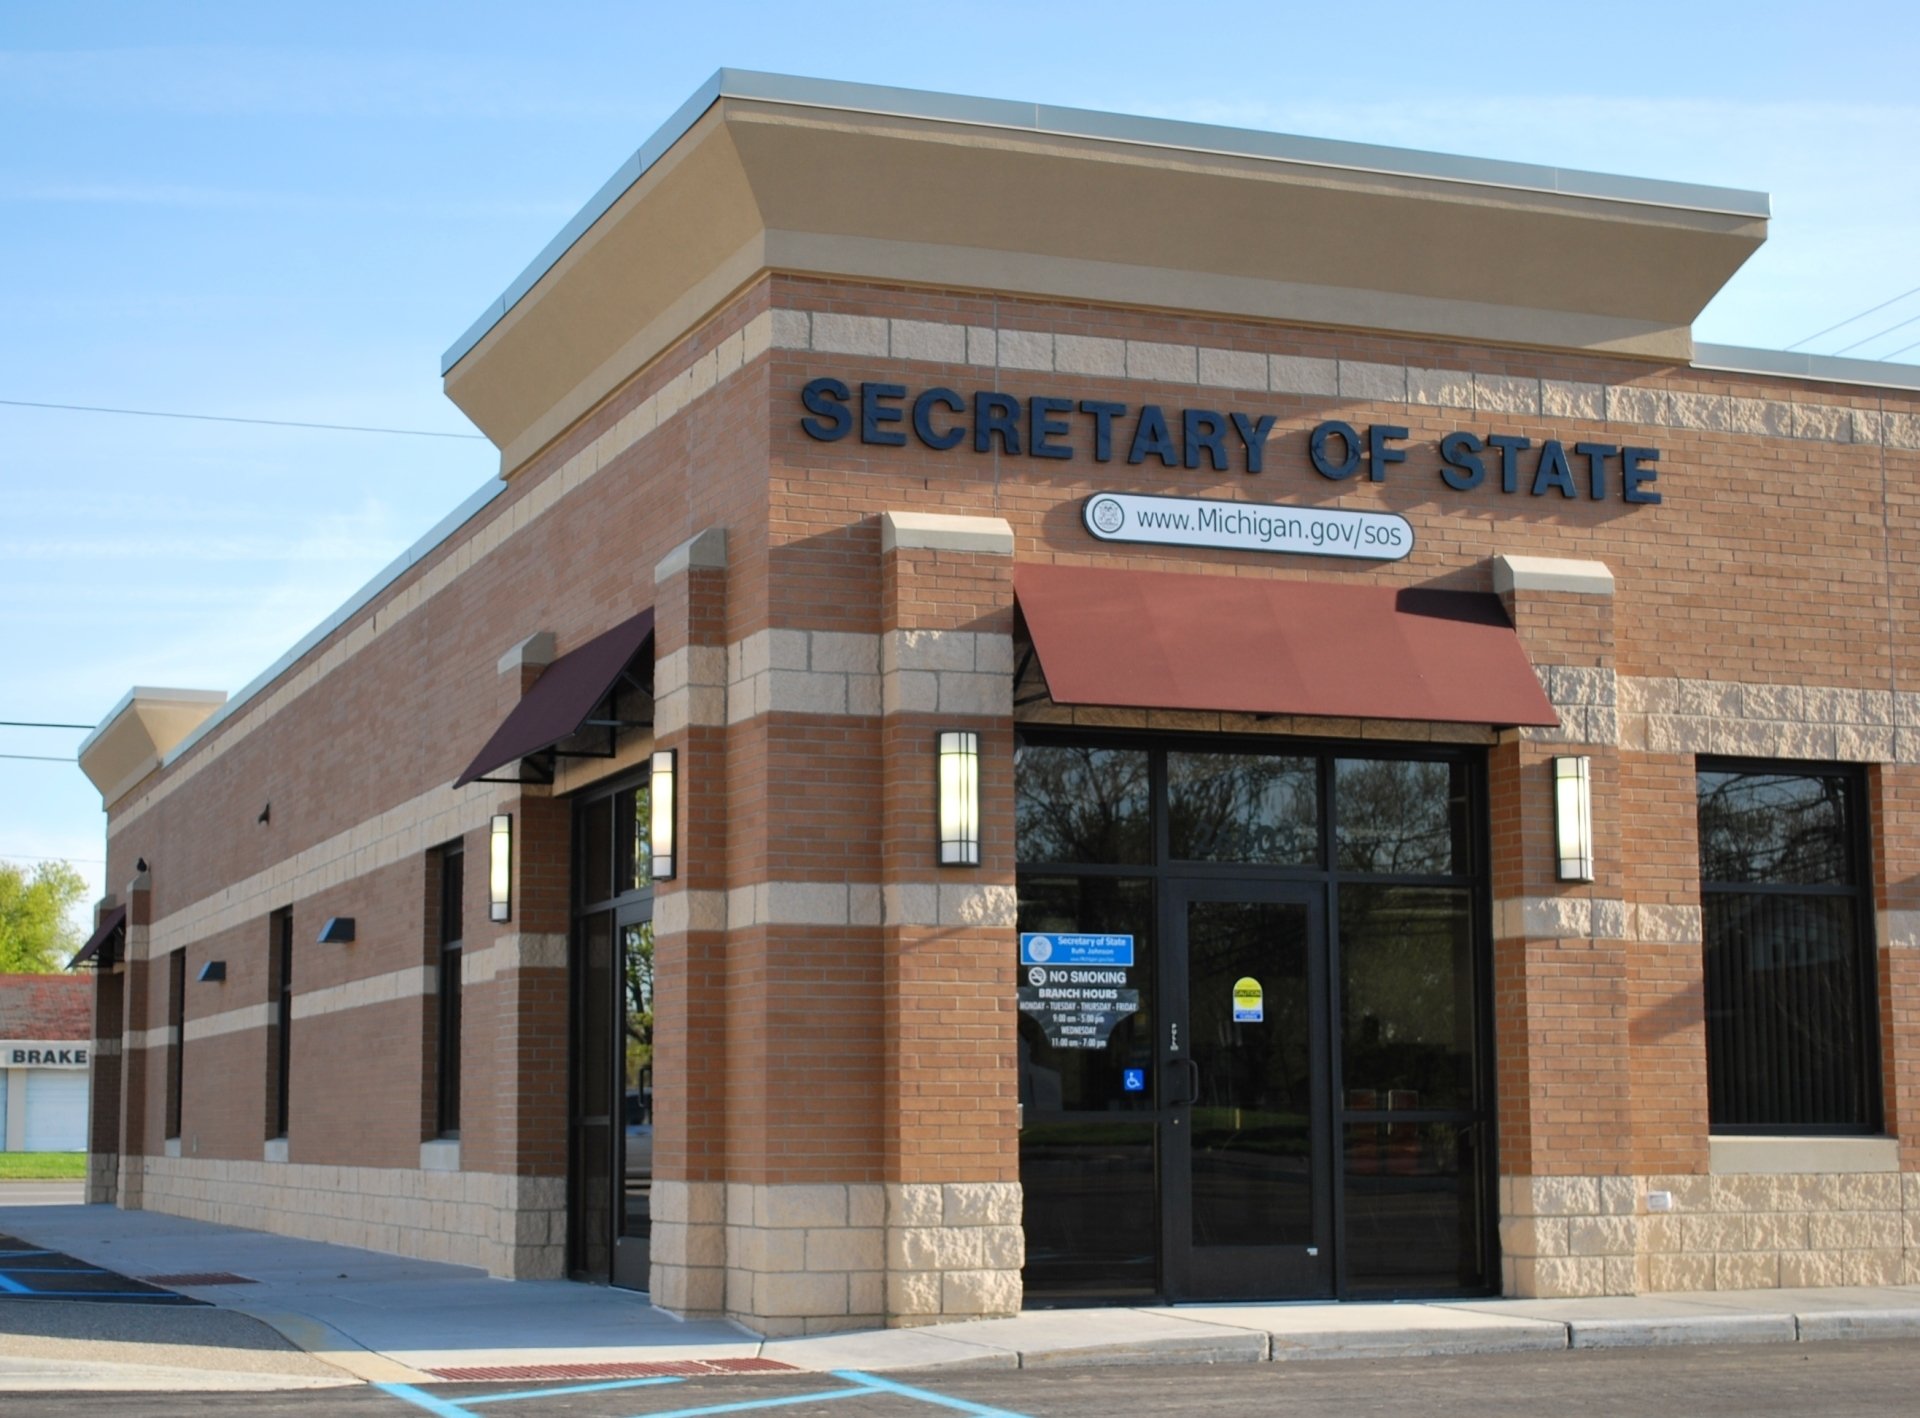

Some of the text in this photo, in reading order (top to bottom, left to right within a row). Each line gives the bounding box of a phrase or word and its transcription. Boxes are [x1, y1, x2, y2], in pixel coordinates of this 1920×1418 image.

[800, 376, 1663, 505] SECRETARY OF STATE
[1137, 507, 1402, 549] www.Michigan.gov/sos
[1057, 936, 1126, 947] Secretary of State
[1049, 970, 1127, 984] NO SMOKING
[1038, 988, 1118, 999] BRANCH HOURS
[1019, 1001, 1045, 1010] MONDAY
[1049, 1001, 1076, 1010] TUESDAY
[1080, 1002, 1112, 1011] THURSDAY
[1115, 1002, 1137, 1011] FRIDAY
[1060, 1026, 1097, 1035] WEDNESDAY
[12, 1049, 88, 1064] BRAKE
